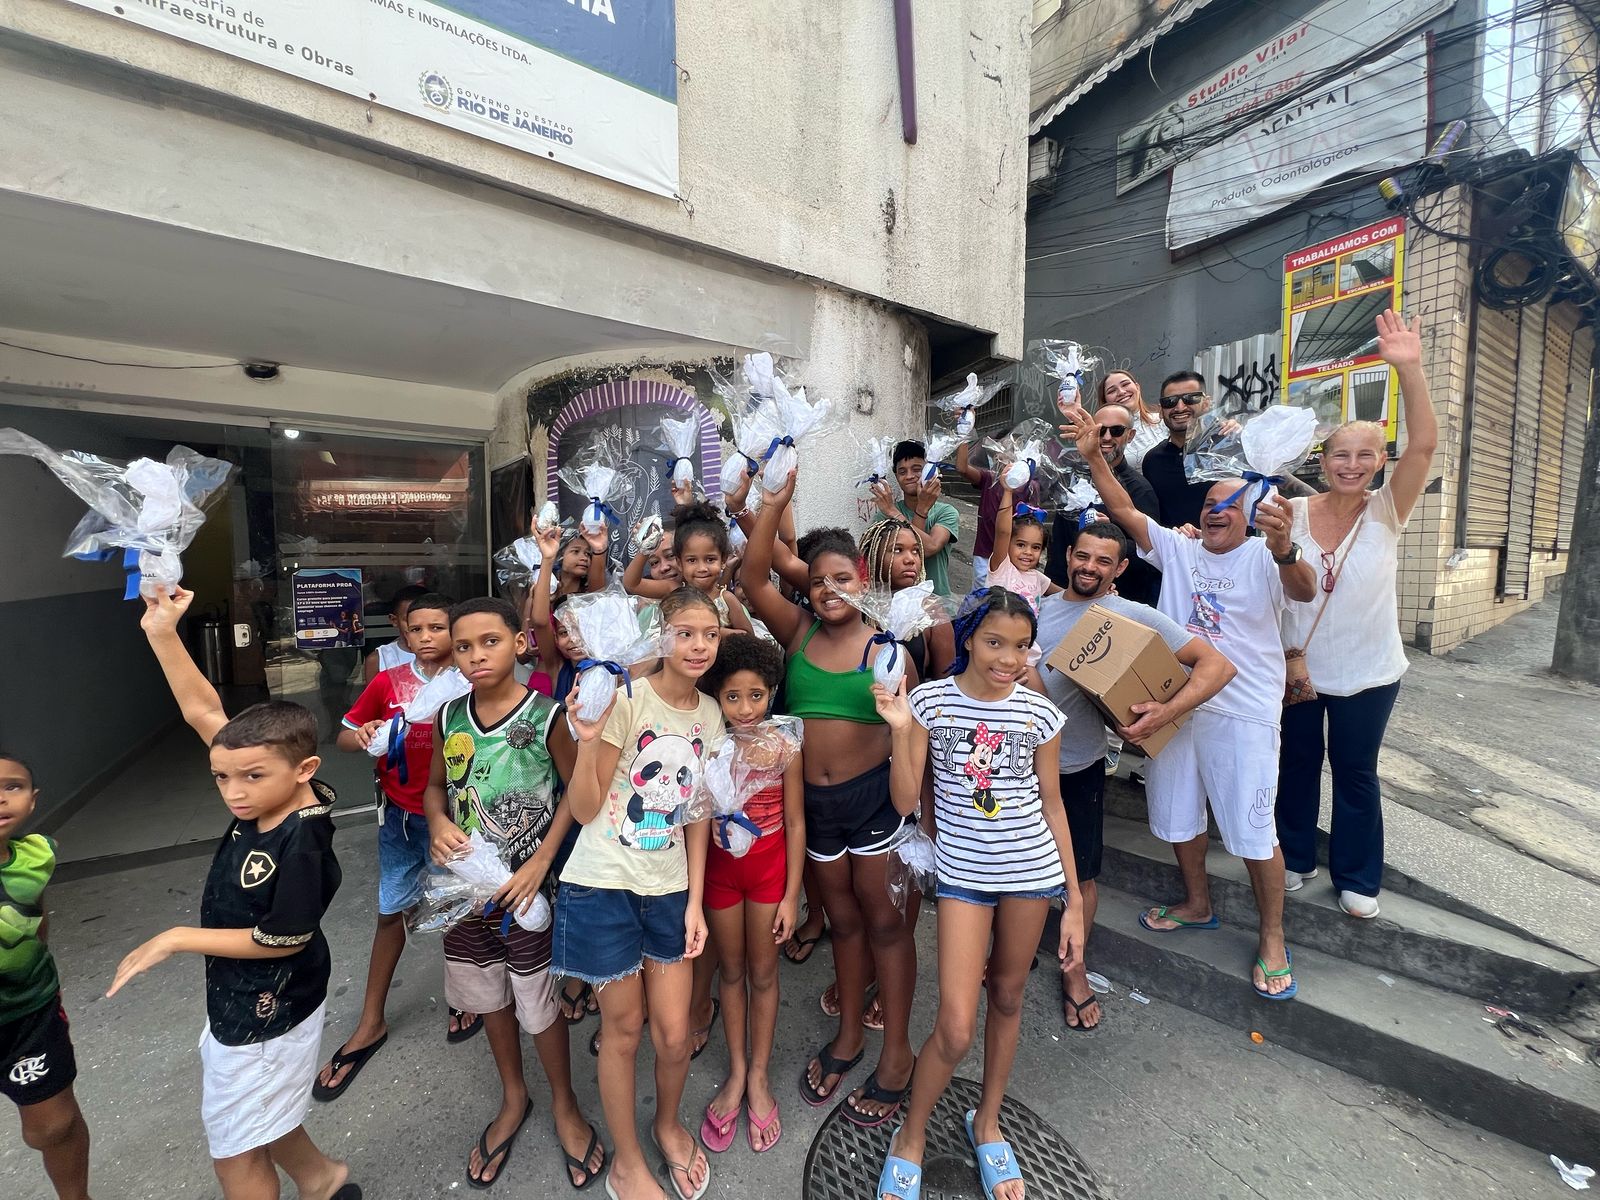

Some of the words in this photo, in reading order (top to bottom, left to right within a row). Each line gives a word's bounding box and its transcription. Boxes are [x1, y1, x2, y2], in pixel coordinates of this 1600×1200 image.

[244, 10, 264, 28] de
[370, 0, 404, 14] MAS
[408, 7, 416, 18] E
[418, 12, 498, 52] INSTALAÇÕES
[502, 45, 532, 66] LTDA.
[285, 43, 294, 54] e
[302, 46, 354, 76] Obras
[1188, 64, 1248, 107] Studio
[1256, 24, 1309, 63] Vilar
[457, 88, 510, 111] GOVERNO
[516, 108, 529, 118] DO
[535, 115, 573, 133] ESTADO
[457, 96, 486, 115] RIO
[489, 107, 509, 124] DE
[512, 117, 573, 145] JANEIRO
[1212, 182, 1257, 208] Produtos
[1261, 144, 1360, 187] Odontológicos
[1292, 234, 1368, 266] TRABALHAMOS
[1372, 224, 1398, 240] COM
[1318, 360, 1354, 372] TELHADO
[1069, 620, 1113, 671] Colgate
